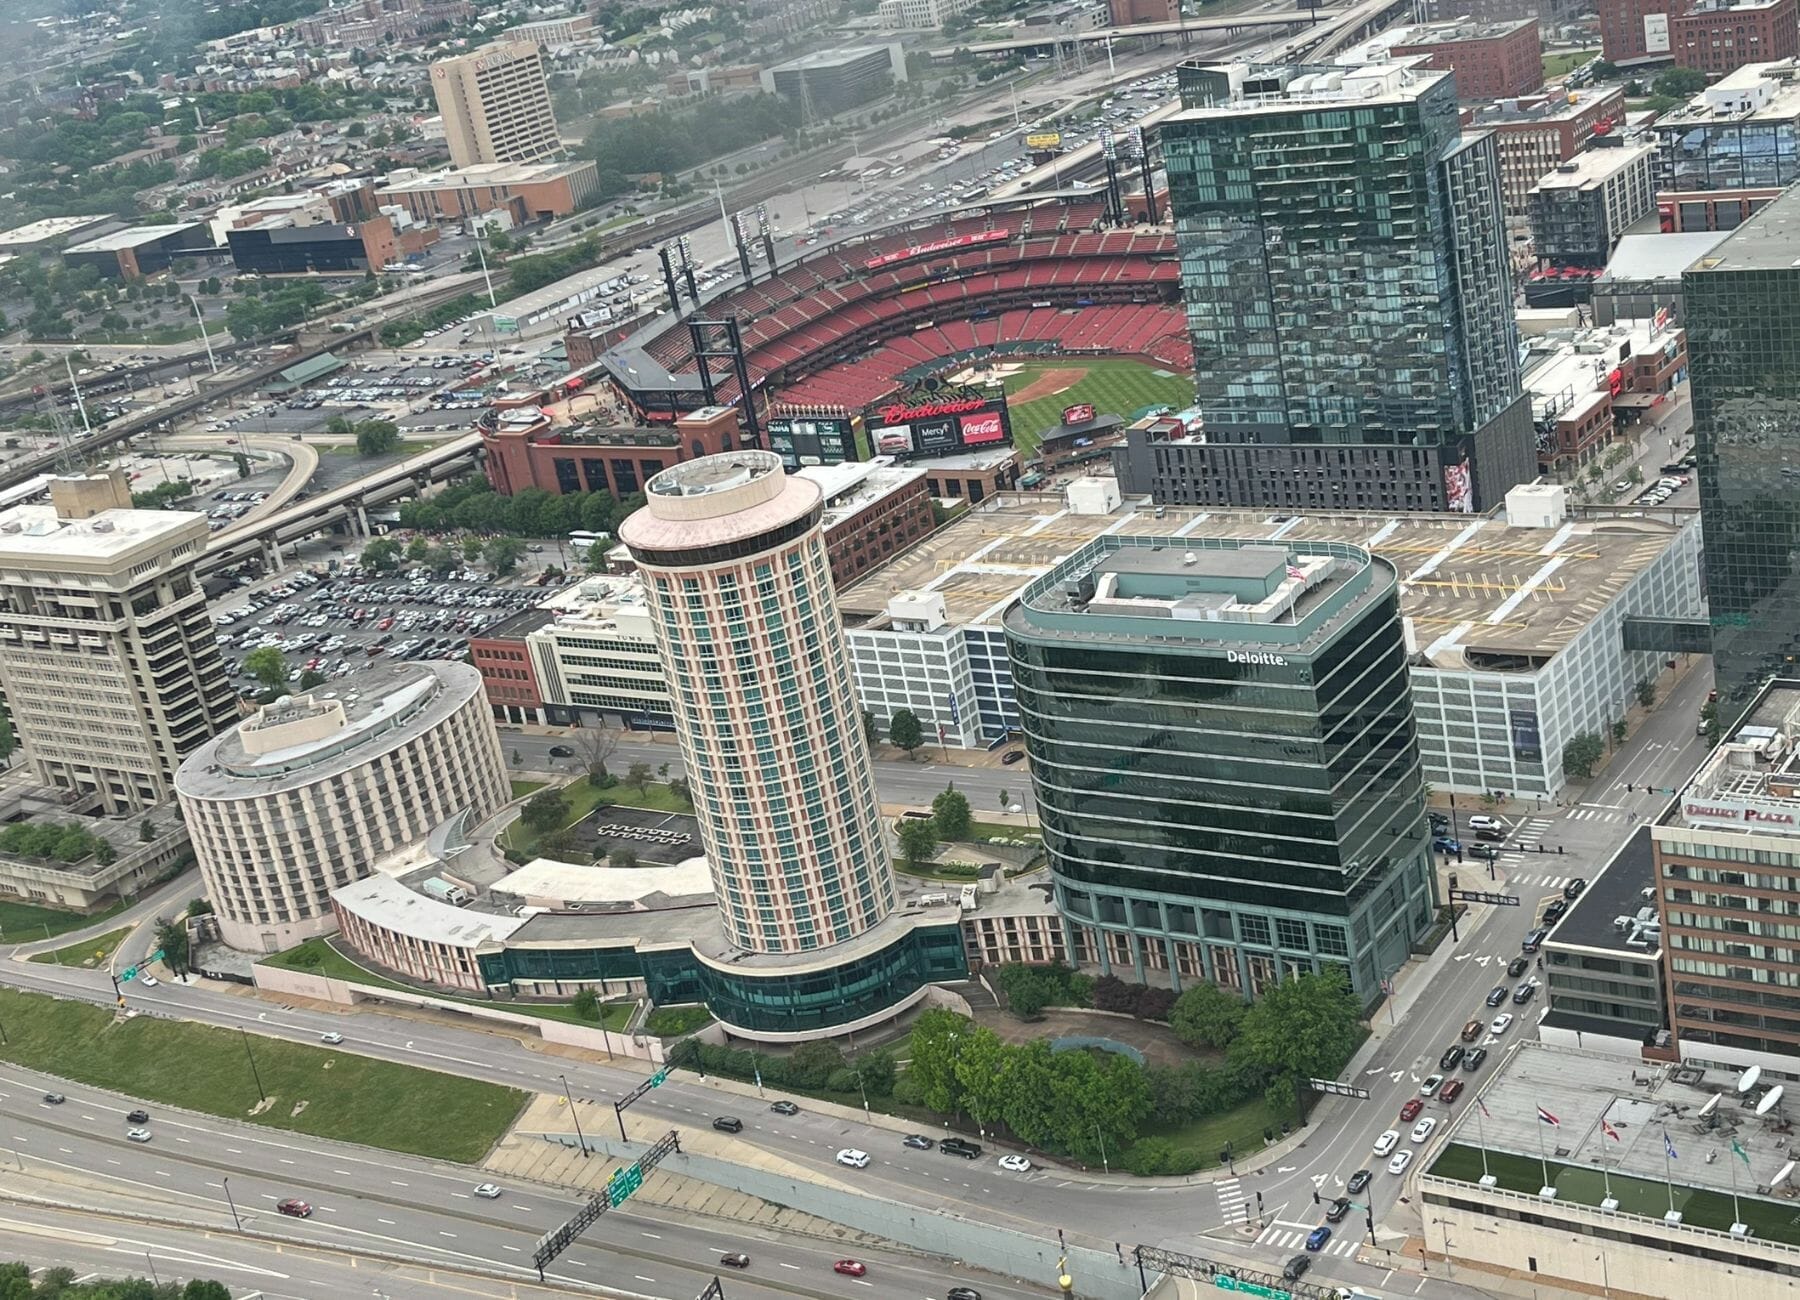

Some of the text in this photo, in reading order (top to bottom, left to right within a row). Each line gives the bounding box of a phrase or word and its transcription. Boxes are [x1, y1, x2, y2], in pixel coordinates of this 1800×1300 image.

[909, 238, 963, 256] Budweiser
[877, 399, 985, 424] Budweiser
[921, 428, 944, 437] Mercy
[616, 634, 642, 642] TUMS
[1227, 650, 1288, 666] Deloitte.
